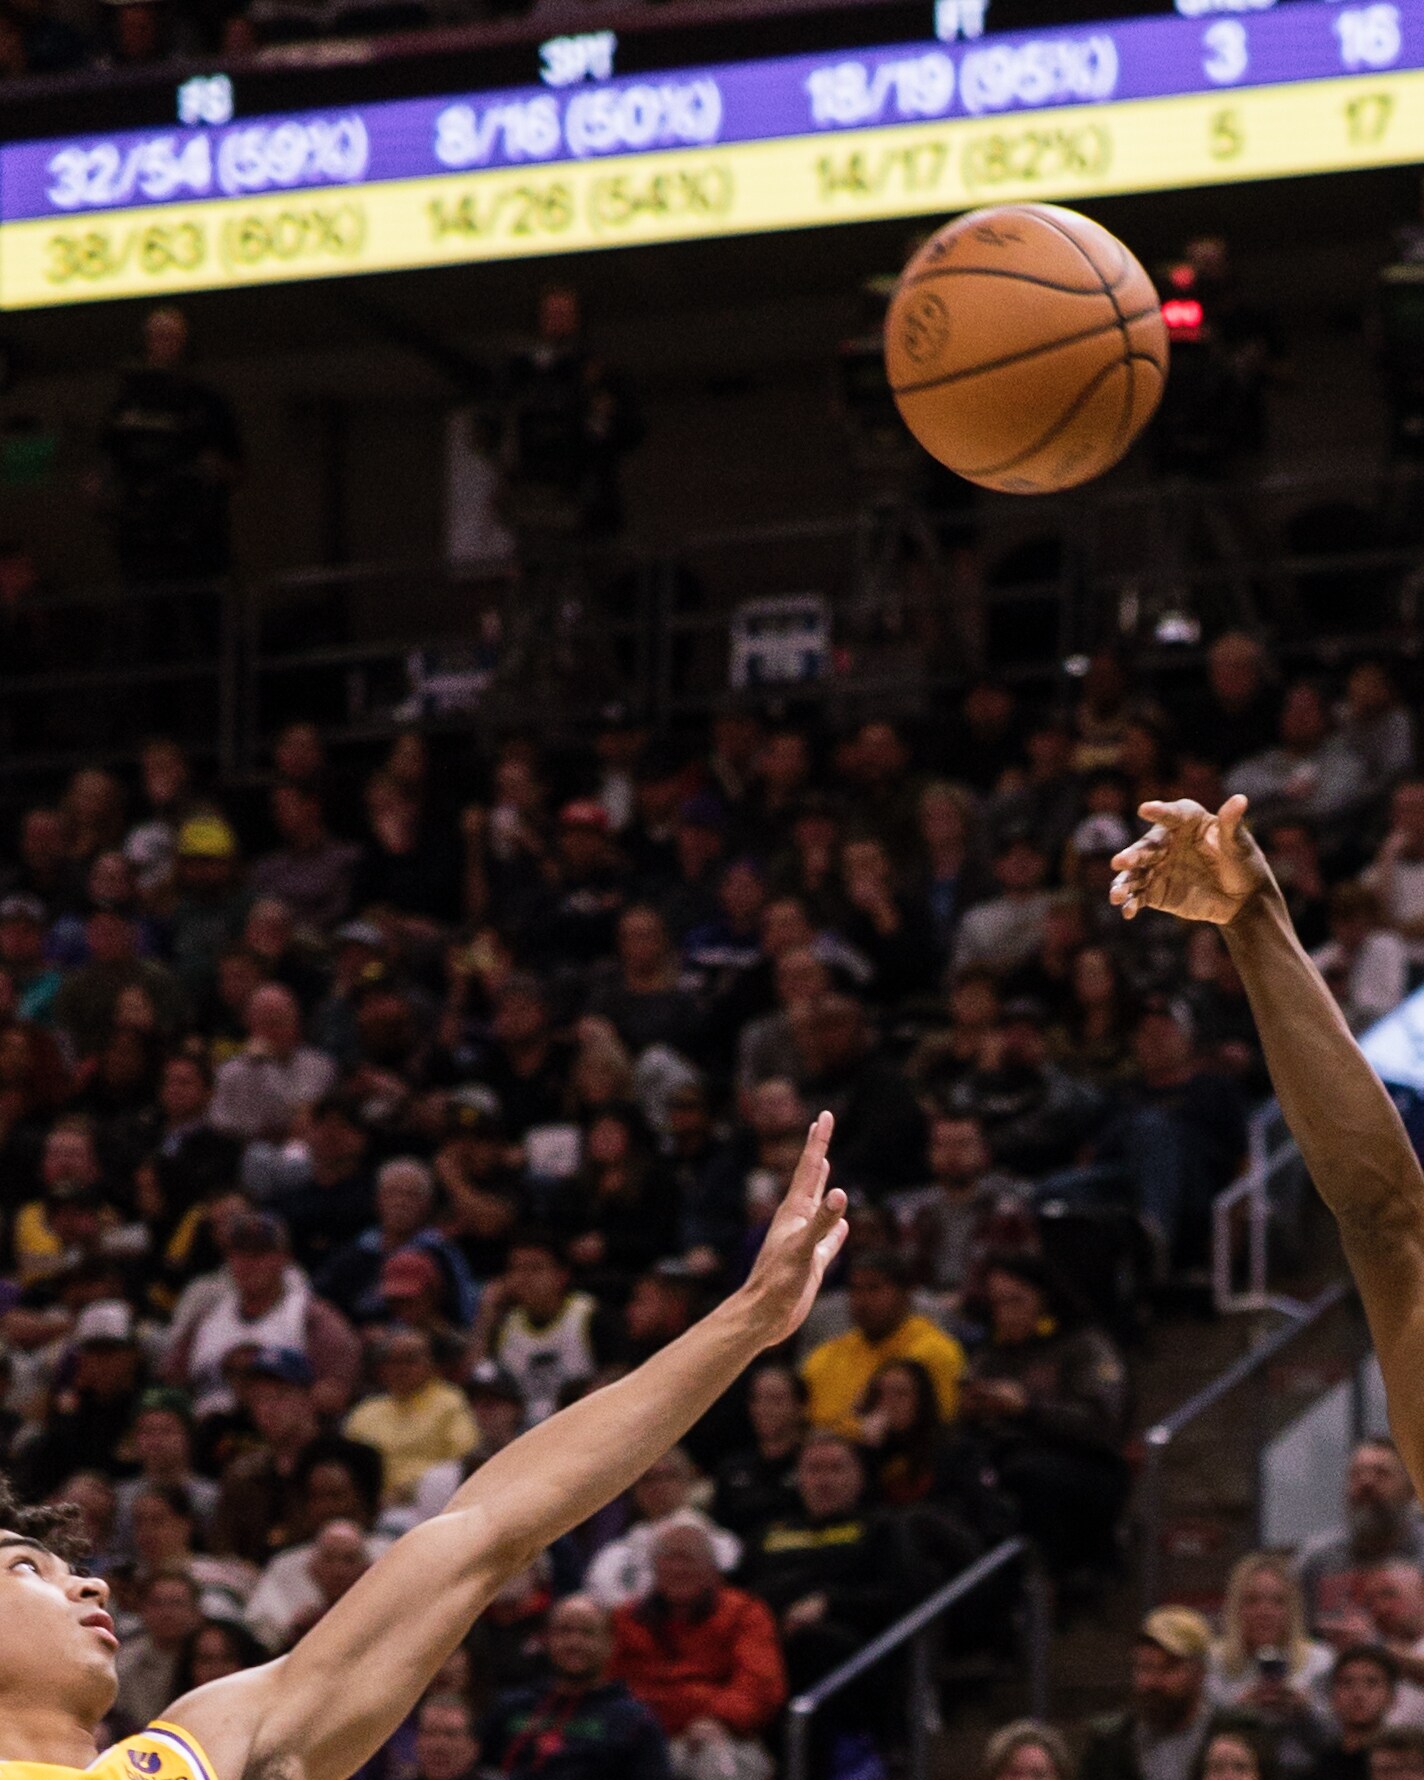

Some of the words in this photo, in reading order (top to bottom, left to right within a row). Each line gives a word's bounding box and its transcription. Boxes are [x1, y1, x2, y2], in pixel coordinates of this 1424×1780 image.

[1204, 20, 1246, 82] 3
[1335, 4, 1399, 68] 16
[436, 96, 560, 167] 8/16
[565, 77, 721, 158] (50%)
[808, 54, 954, 126] 18/19
[1343, 94, 1395, 146] 17
[48, 133, 211, 208] 32/54
[217, 113, 368, 193] (59%)
[814, 142, 948, 200] 14/17
[960, 123, 1112, 195] (82%)
[1207, 108, 1244, 161] 5
[428, 184, 573, 243] 14/26
[588, 165, 735, 235] (54%)
[47, 222, 205, 283] 38/63
[218, 202, 369, 275] (60%)
